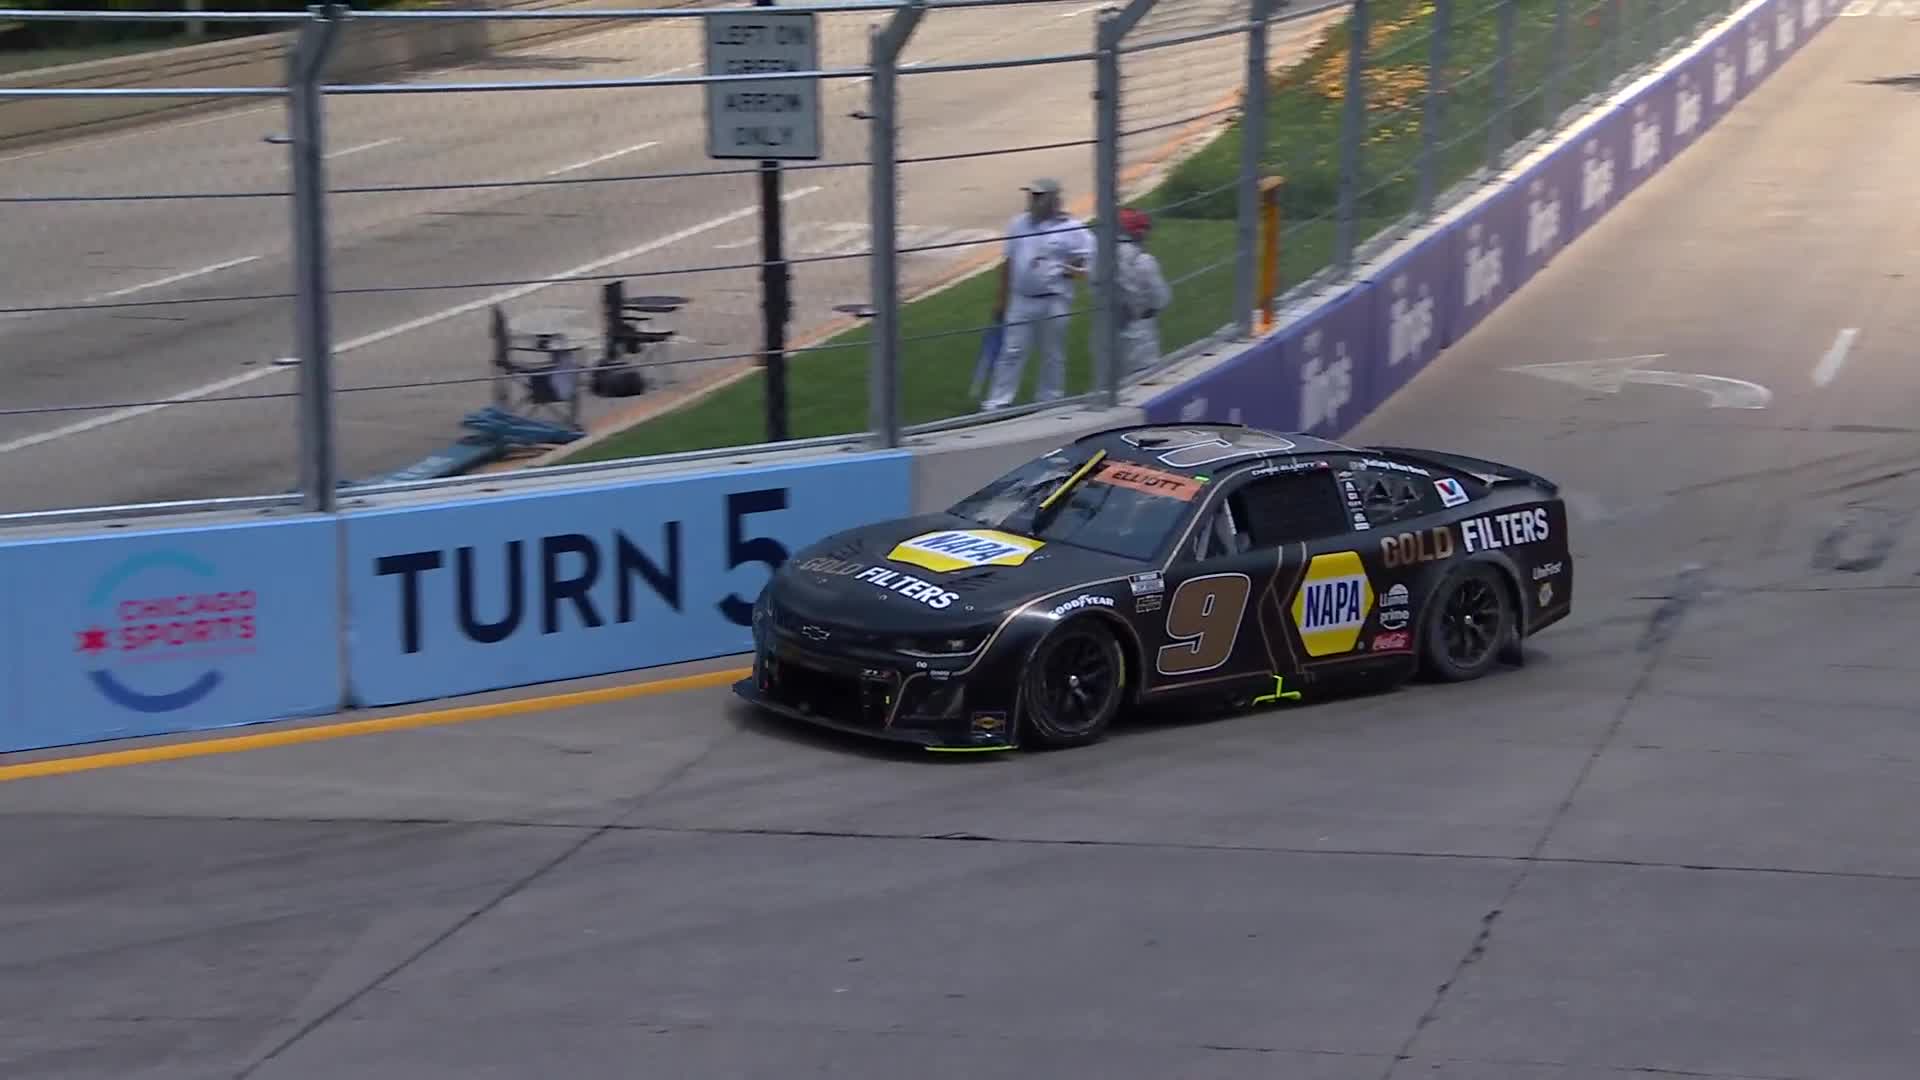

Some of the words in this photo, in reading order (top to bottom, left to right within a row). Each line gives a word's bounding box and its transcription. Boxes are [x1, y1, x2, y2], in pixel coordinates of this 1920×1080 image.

[715, 25, 769, 46] LEFT
[776, 24, 808, 46] ON
[726, 93, 802, 112] ARROW
[735, 127, 794, 146] ONLY
[1111, 470, 1185, 491] ELLIOTT
[912, 533, 1021, 562] NAPA
[1380, 526, 1453, 569] GOLD
[1460, 507, 1549, 552] FILTERS
[374, 520, 682, 654] TURN
[717, 487, 791, 626] 5
[800, 557, 864, 576] GOLD
[855, 566, 960, 610] FILTERS
[119, 589, 256, 621] CHICAGO
[1047, 594, 1115, 621] GOODYEAR
[1305, 580, 1361, 628] NAPA
[1380, 609, 1410, 625] prime
[121, 615, 256, 651] SPORTS
[1156, 572, 1251, 675] 9
